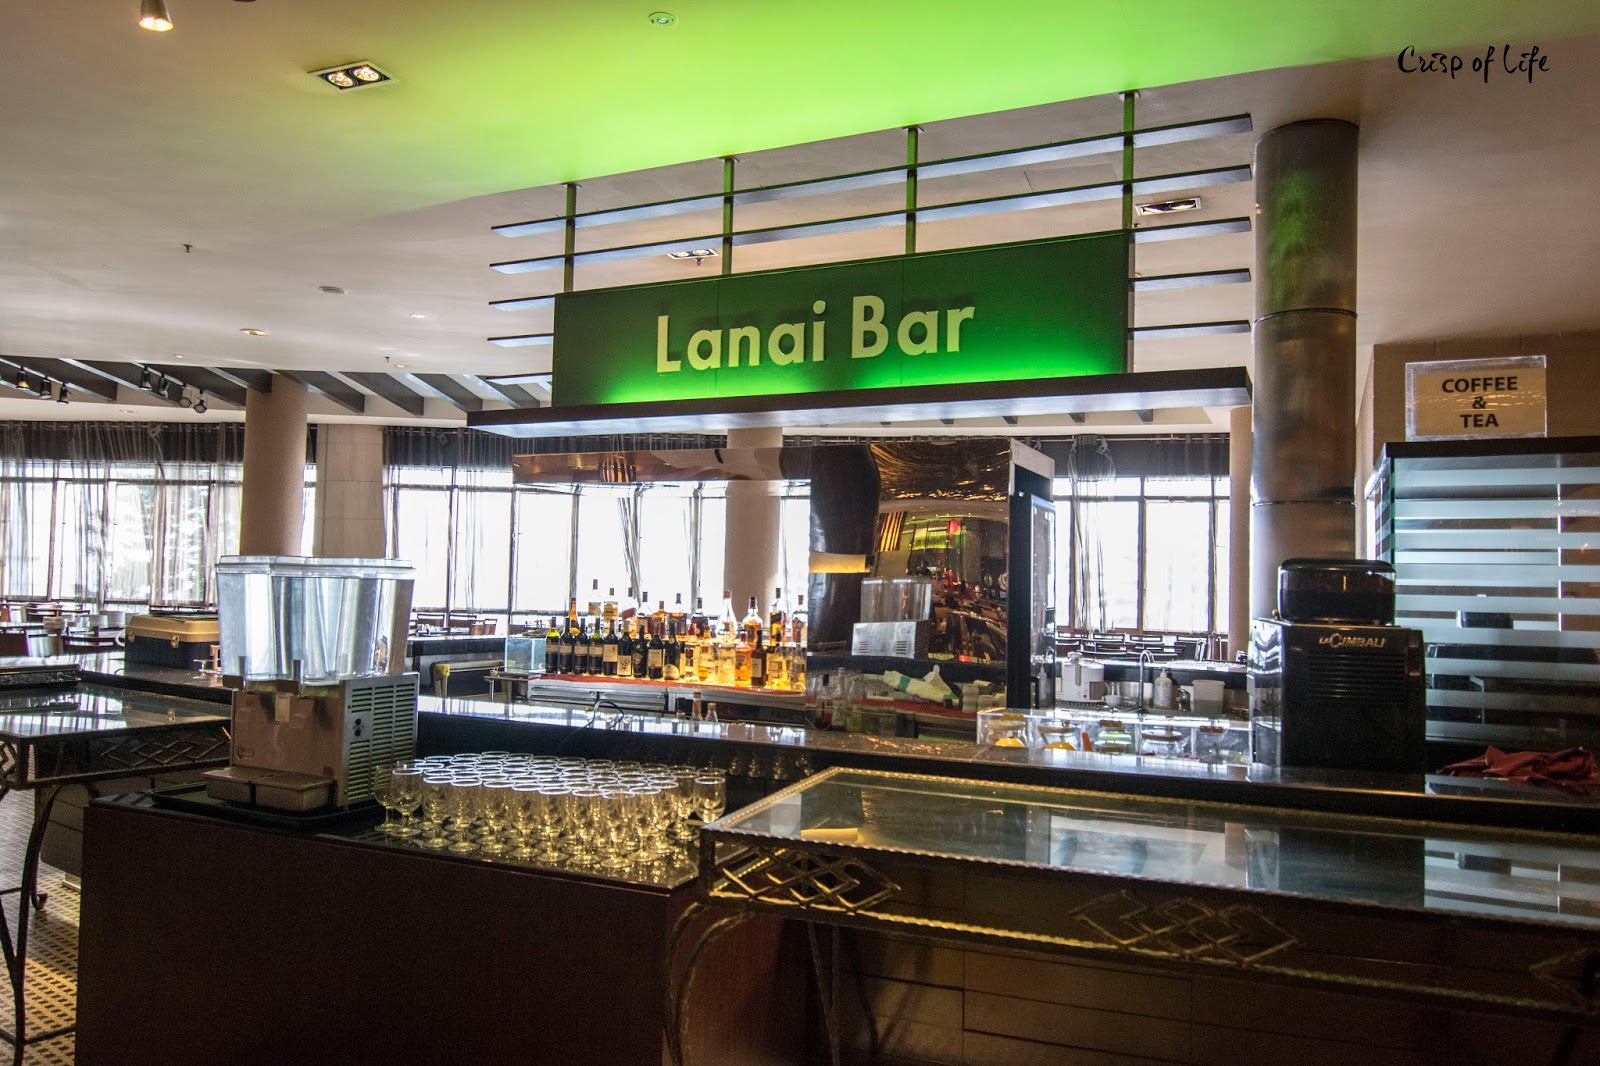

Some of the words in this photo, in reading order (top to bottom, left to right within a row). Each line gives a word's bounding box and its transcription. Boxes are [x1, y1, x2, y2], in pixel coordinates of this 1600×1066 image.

[656, 299, 827, 374] Lanai
[851, 294, 976, 360] Bar
[1441, 376, 1518, 393] COFFEE
[1471, 396, 1487, 410] &
[1459, 413, 1499, 428] TEA
